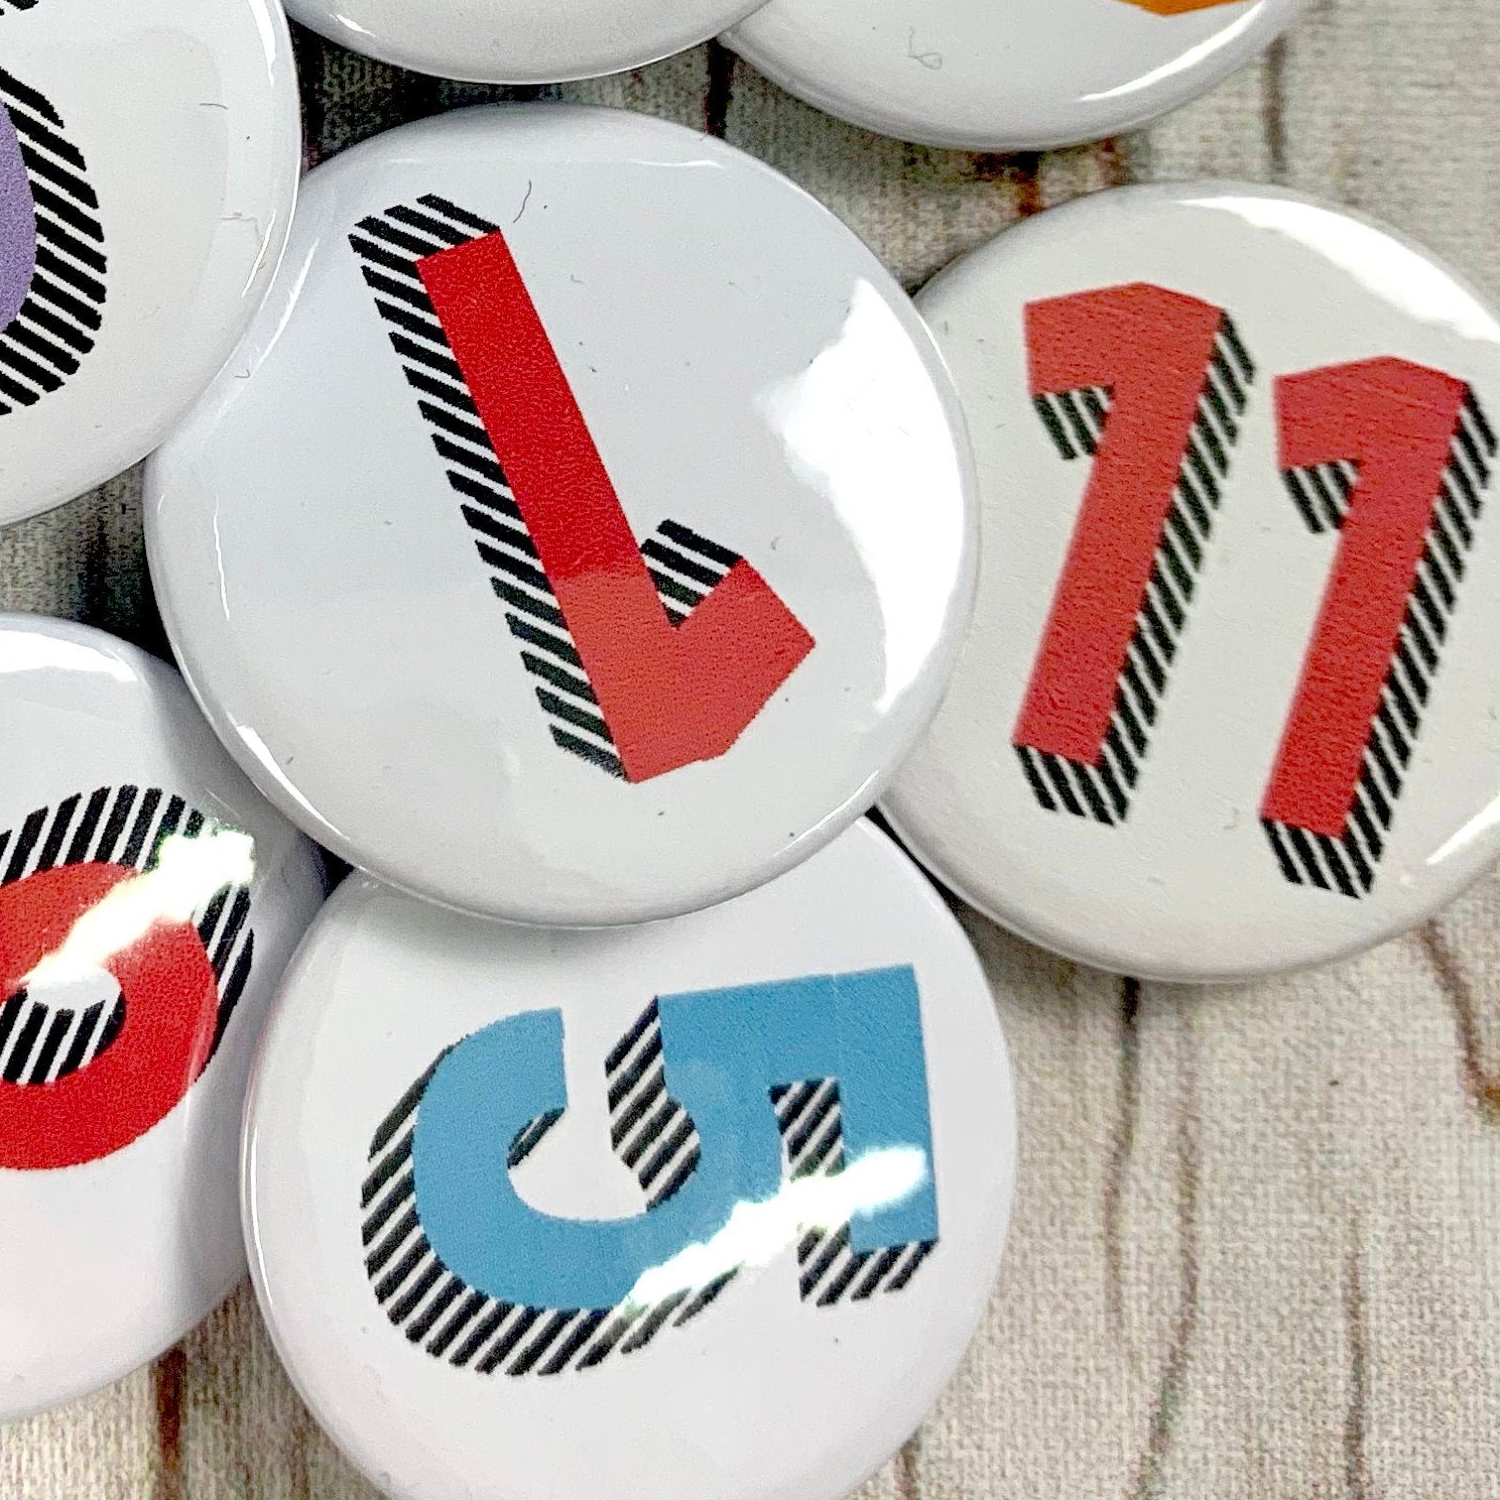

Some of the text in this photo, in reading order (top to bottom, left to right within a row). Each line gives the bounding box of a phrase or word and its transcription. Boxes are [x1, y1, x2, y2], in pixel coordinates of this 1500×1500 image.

[354, 192, 814, 781] 1
[1014, 282, 1495, 897] 11
[362, 964, 941, 1374] 5
